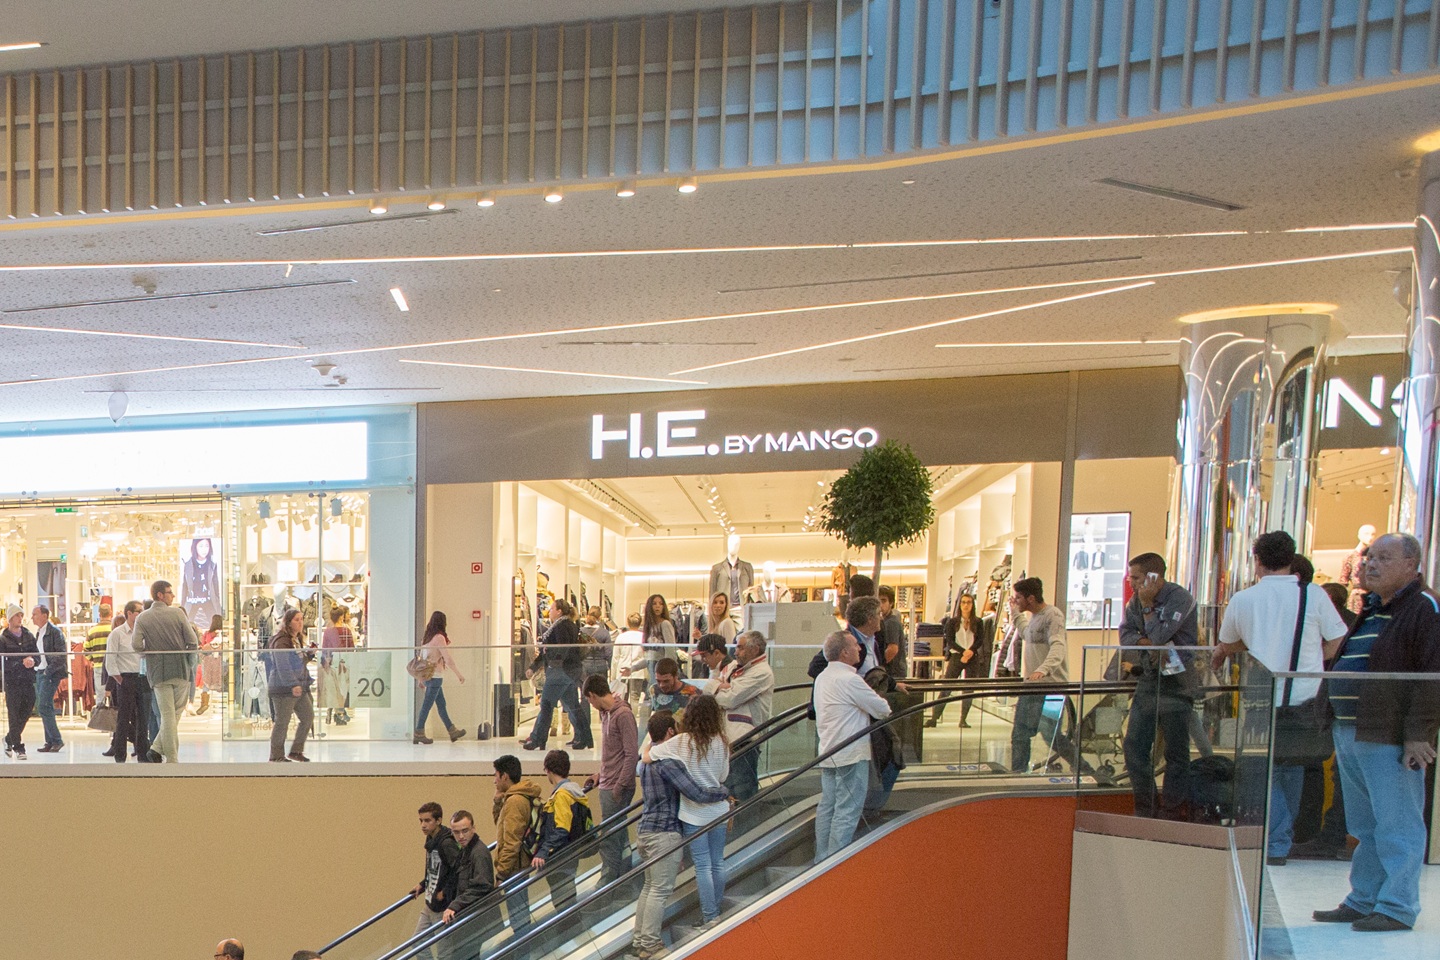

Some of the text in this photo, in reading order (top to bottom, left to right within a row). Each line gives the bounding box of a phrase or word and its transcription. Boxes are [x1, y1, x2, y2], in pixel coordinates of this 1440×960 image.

[591, 409, 878, 459] H.E. BY MANGO
